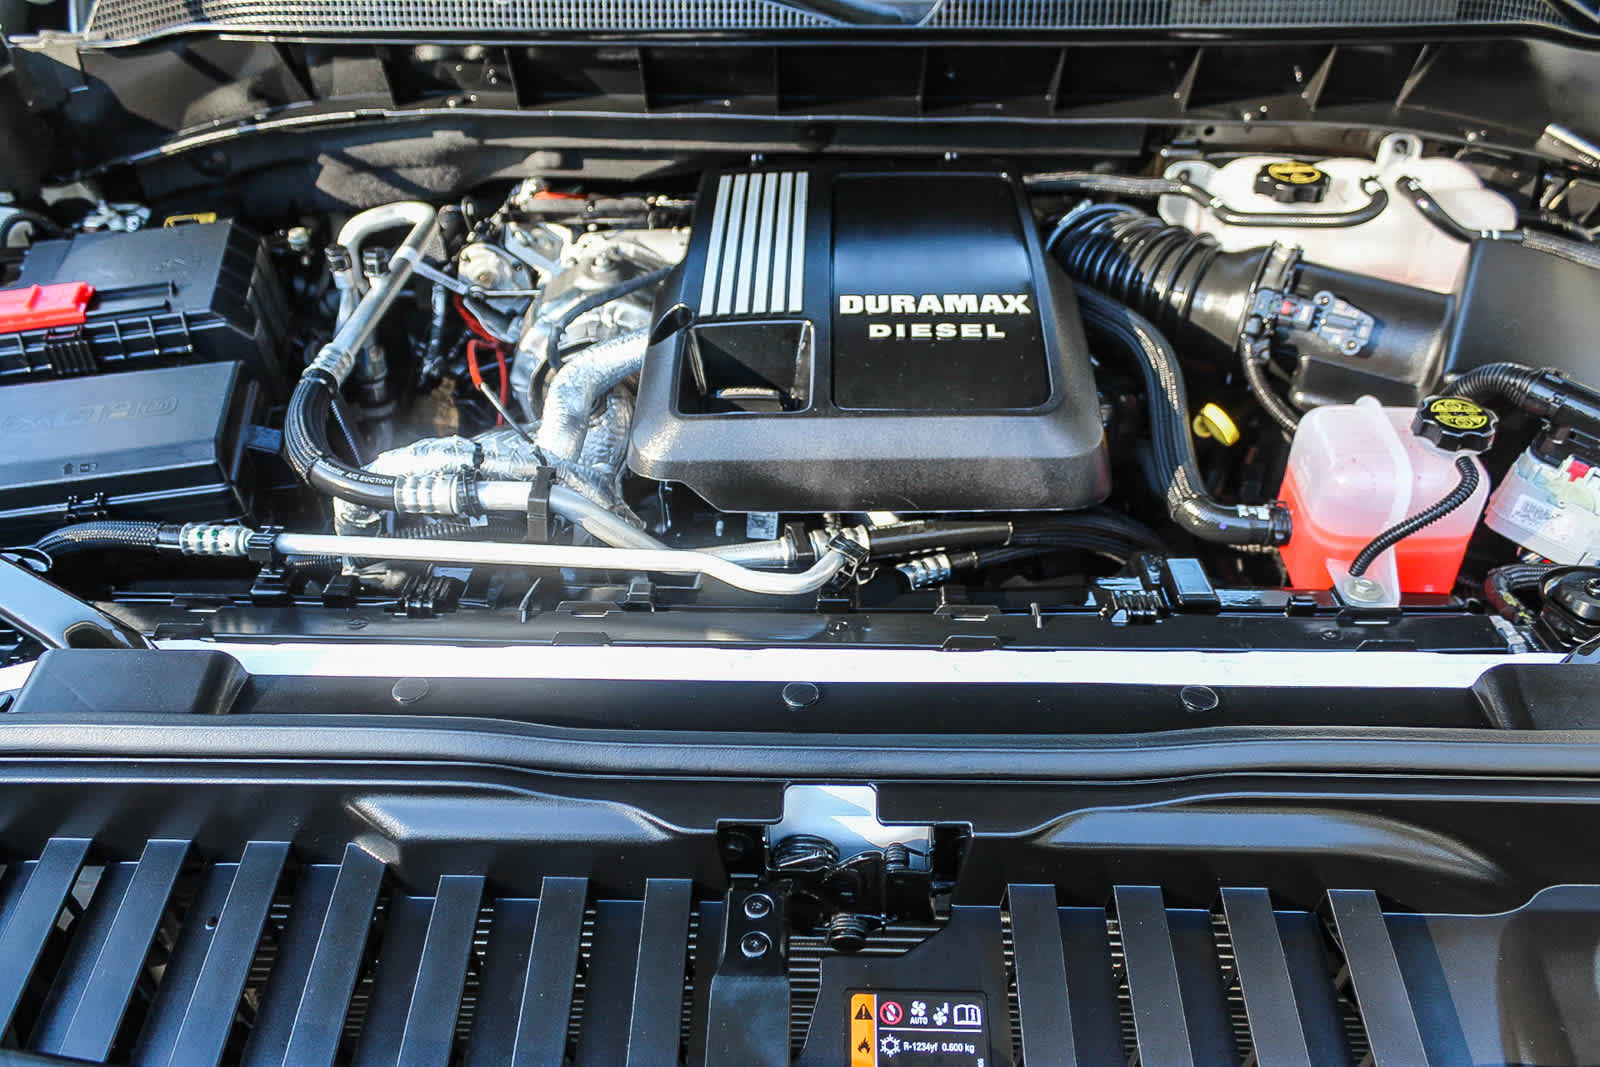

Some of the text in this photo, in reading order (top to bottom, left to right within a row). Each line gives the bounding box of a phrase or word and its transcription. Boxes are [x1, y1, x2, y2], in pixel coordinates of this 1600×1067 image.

[839, 294, 1031, 315] DURAMAX
[868, 323, 1006, 339] DIESEL
[359, 475, 393, 485] SUCTION
[909, 1016, 928, 1025] AUTO
[903, 1042, 975, 1055] R-1234yf 0.600 kg
